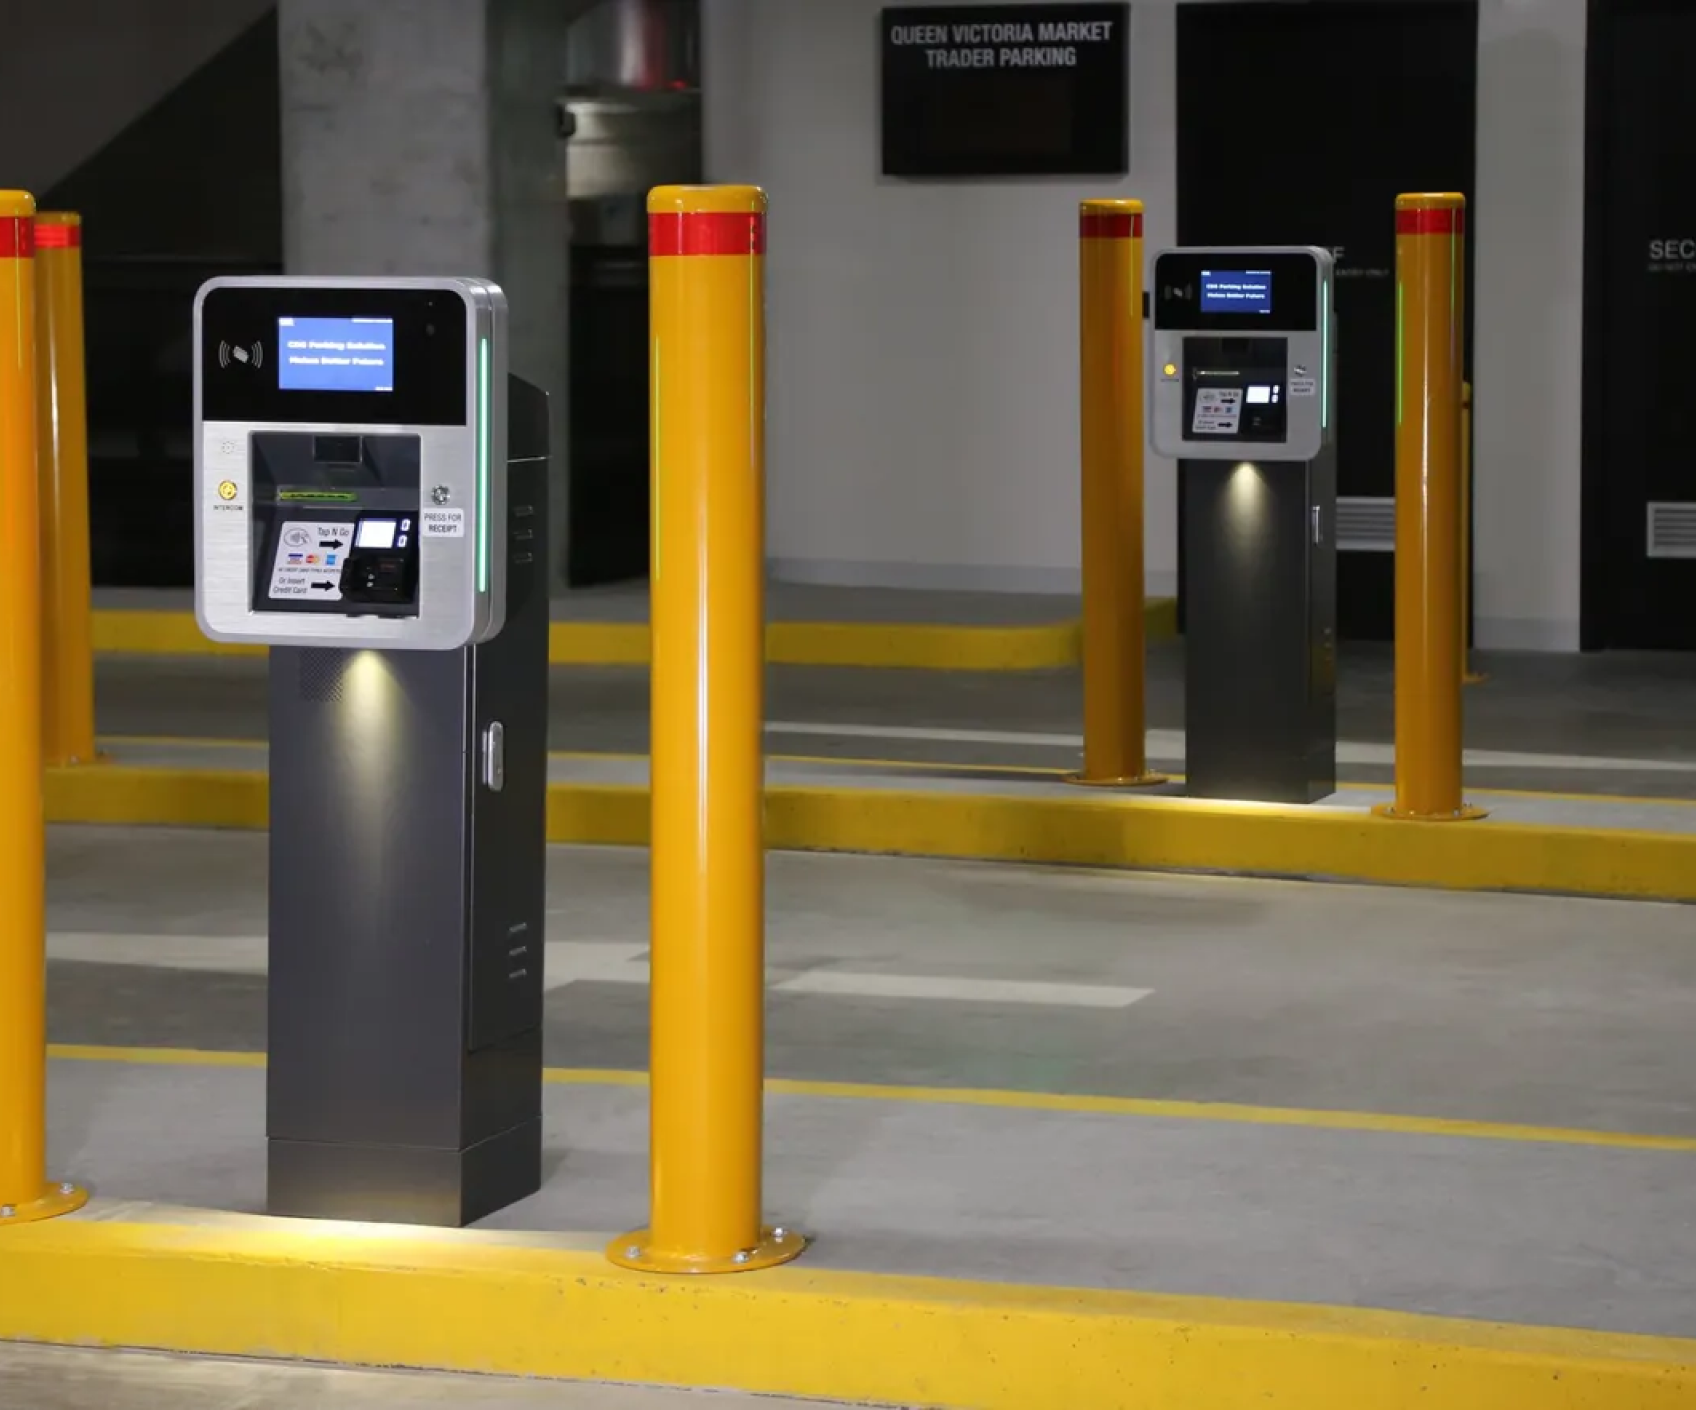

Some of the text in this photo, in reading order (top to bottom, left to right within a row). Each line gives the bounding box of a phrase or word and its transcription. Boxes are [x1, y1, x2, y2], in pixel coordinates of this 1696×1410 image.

[891, 21, 1113, 45] QUEEN VICTORIA MARKET
[925, 46, 1077, 68] TRADER PARKING
[424, 512, 462, 522] PRESS FOR
[317, 527, 350, 538] Tap N Go
[428, 523, 457, 533] RECEIPT
